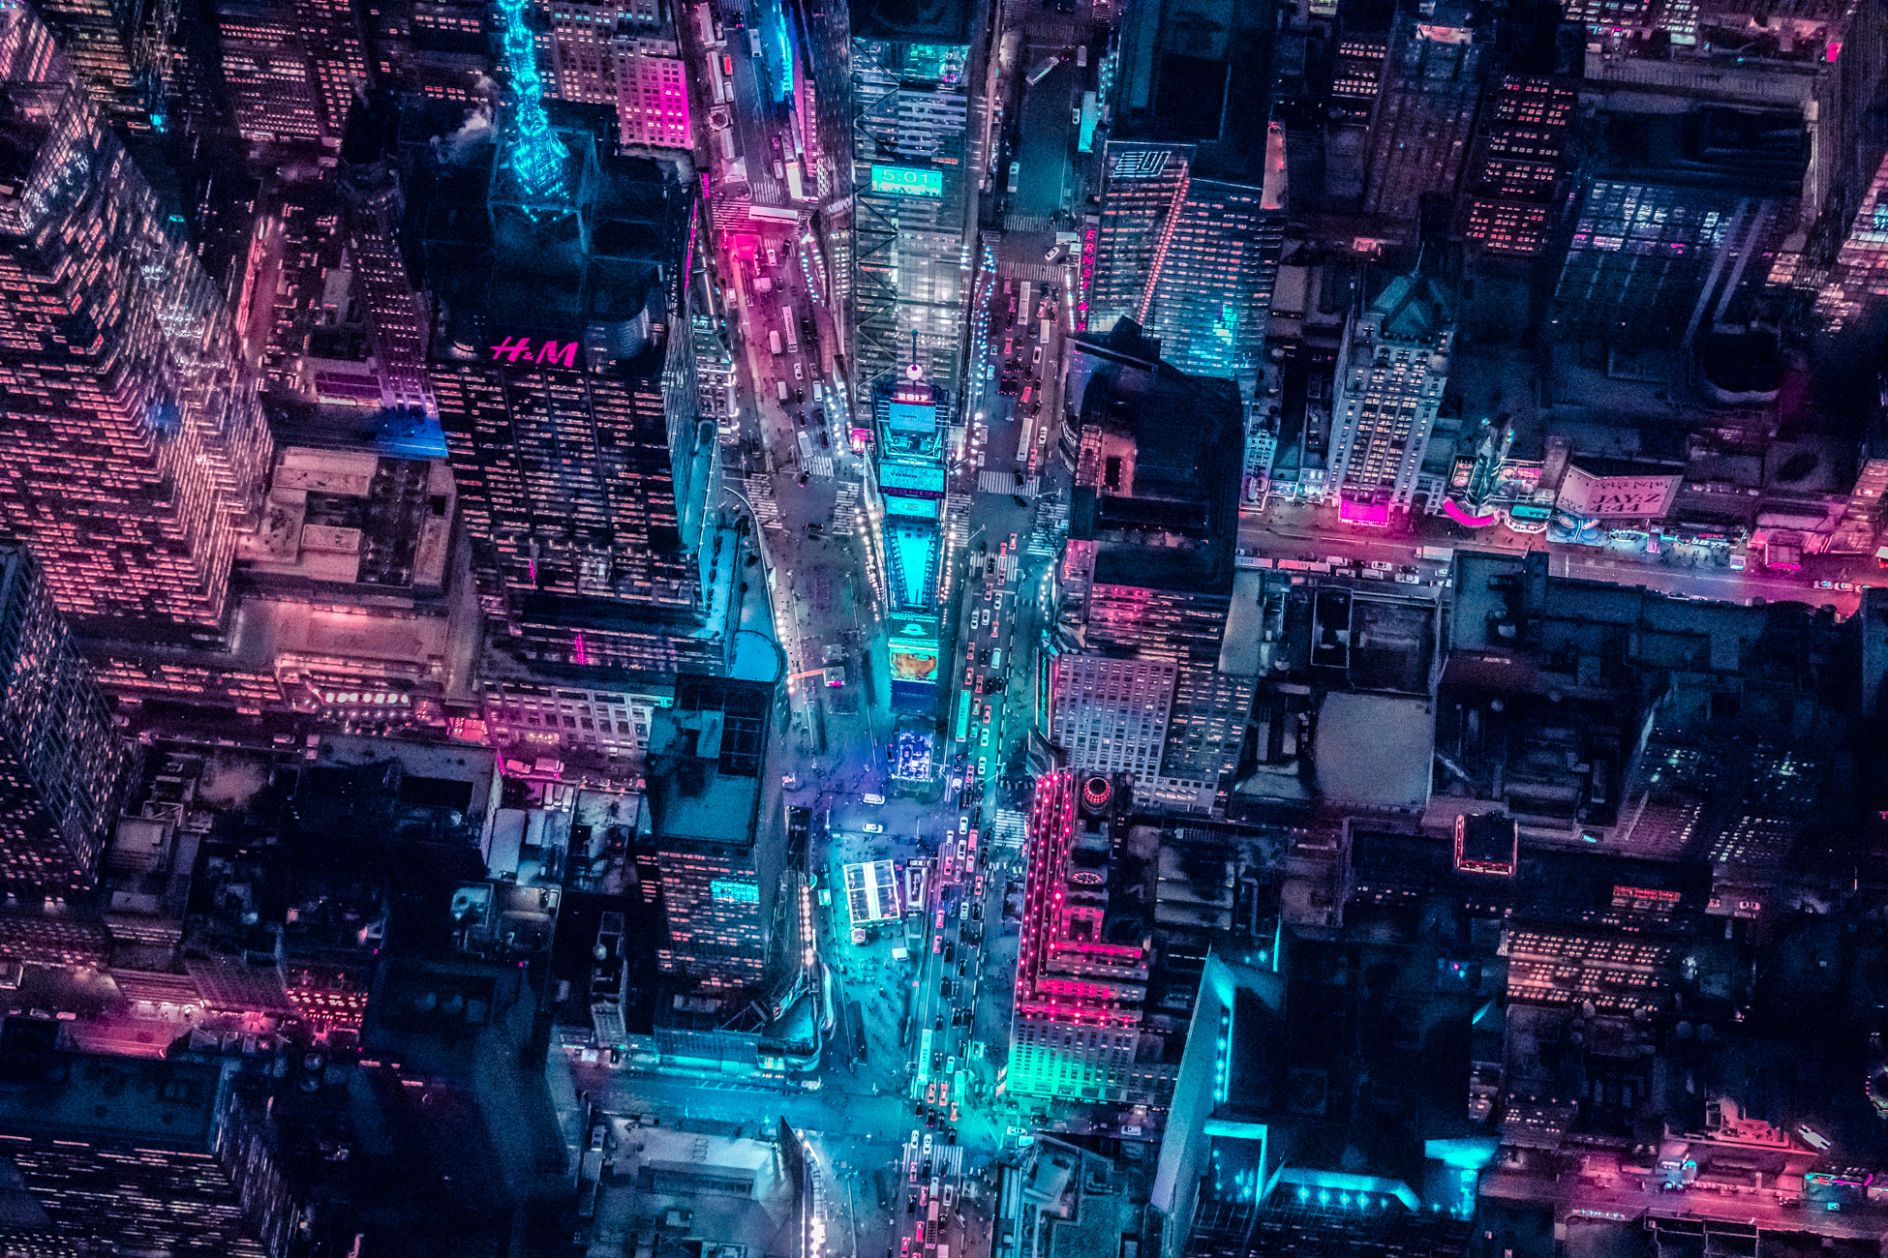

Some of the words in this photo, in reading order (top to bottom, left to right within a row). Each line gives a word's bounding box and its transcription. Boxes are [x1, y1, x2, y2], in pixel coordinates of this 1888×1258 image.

[883, 170, 929, 183] 5:01
[1082, 229, 1096, 290] ERNST
[489, 335, 579, 368] H&M
[1590, 503, 1640, 513] 4:44
